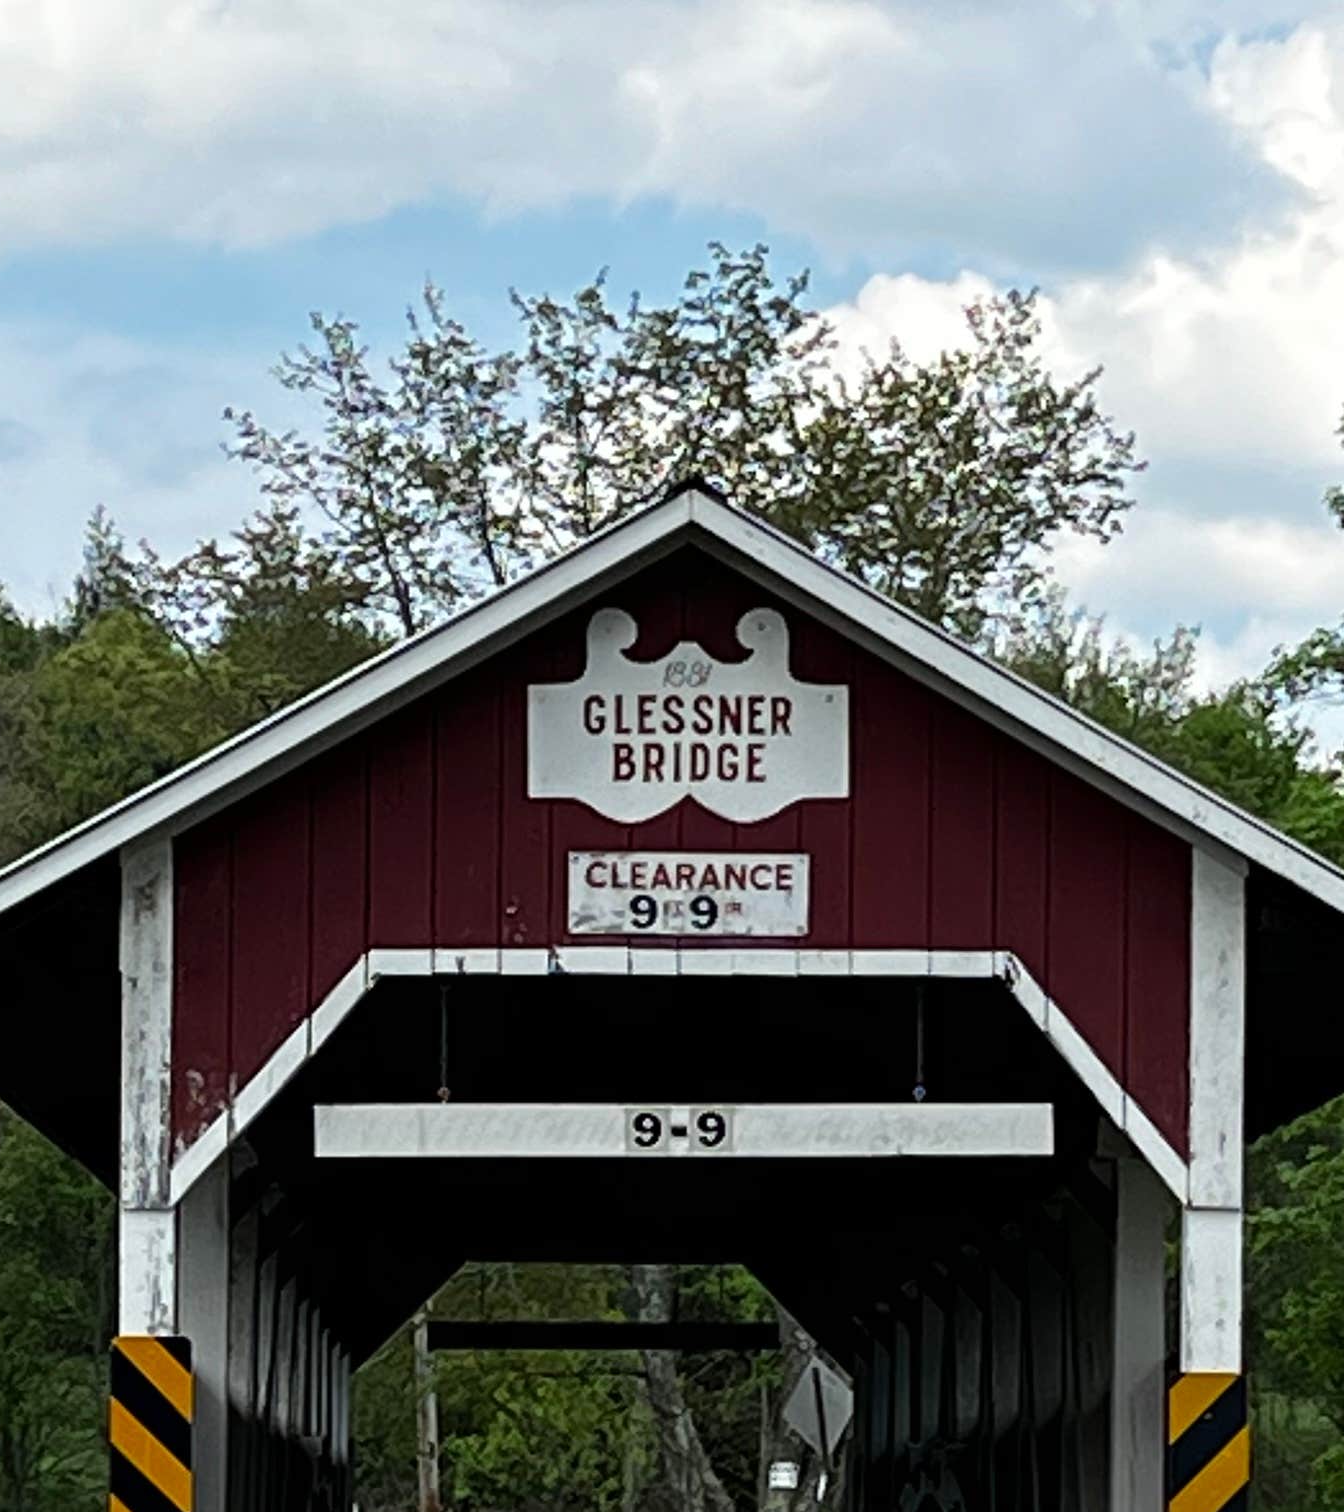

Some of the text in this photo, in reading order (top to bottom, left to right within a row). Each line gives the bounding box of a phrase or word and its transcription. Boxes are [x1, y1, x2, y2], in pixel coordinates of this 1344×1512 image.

[583, 694, 792, 736] GLESSNER
[612, 742, 766, 783] BRIDGE
[585, 861, 794, 891] CLEARANCE
[633, 1112, 726, 1147] 9-9
